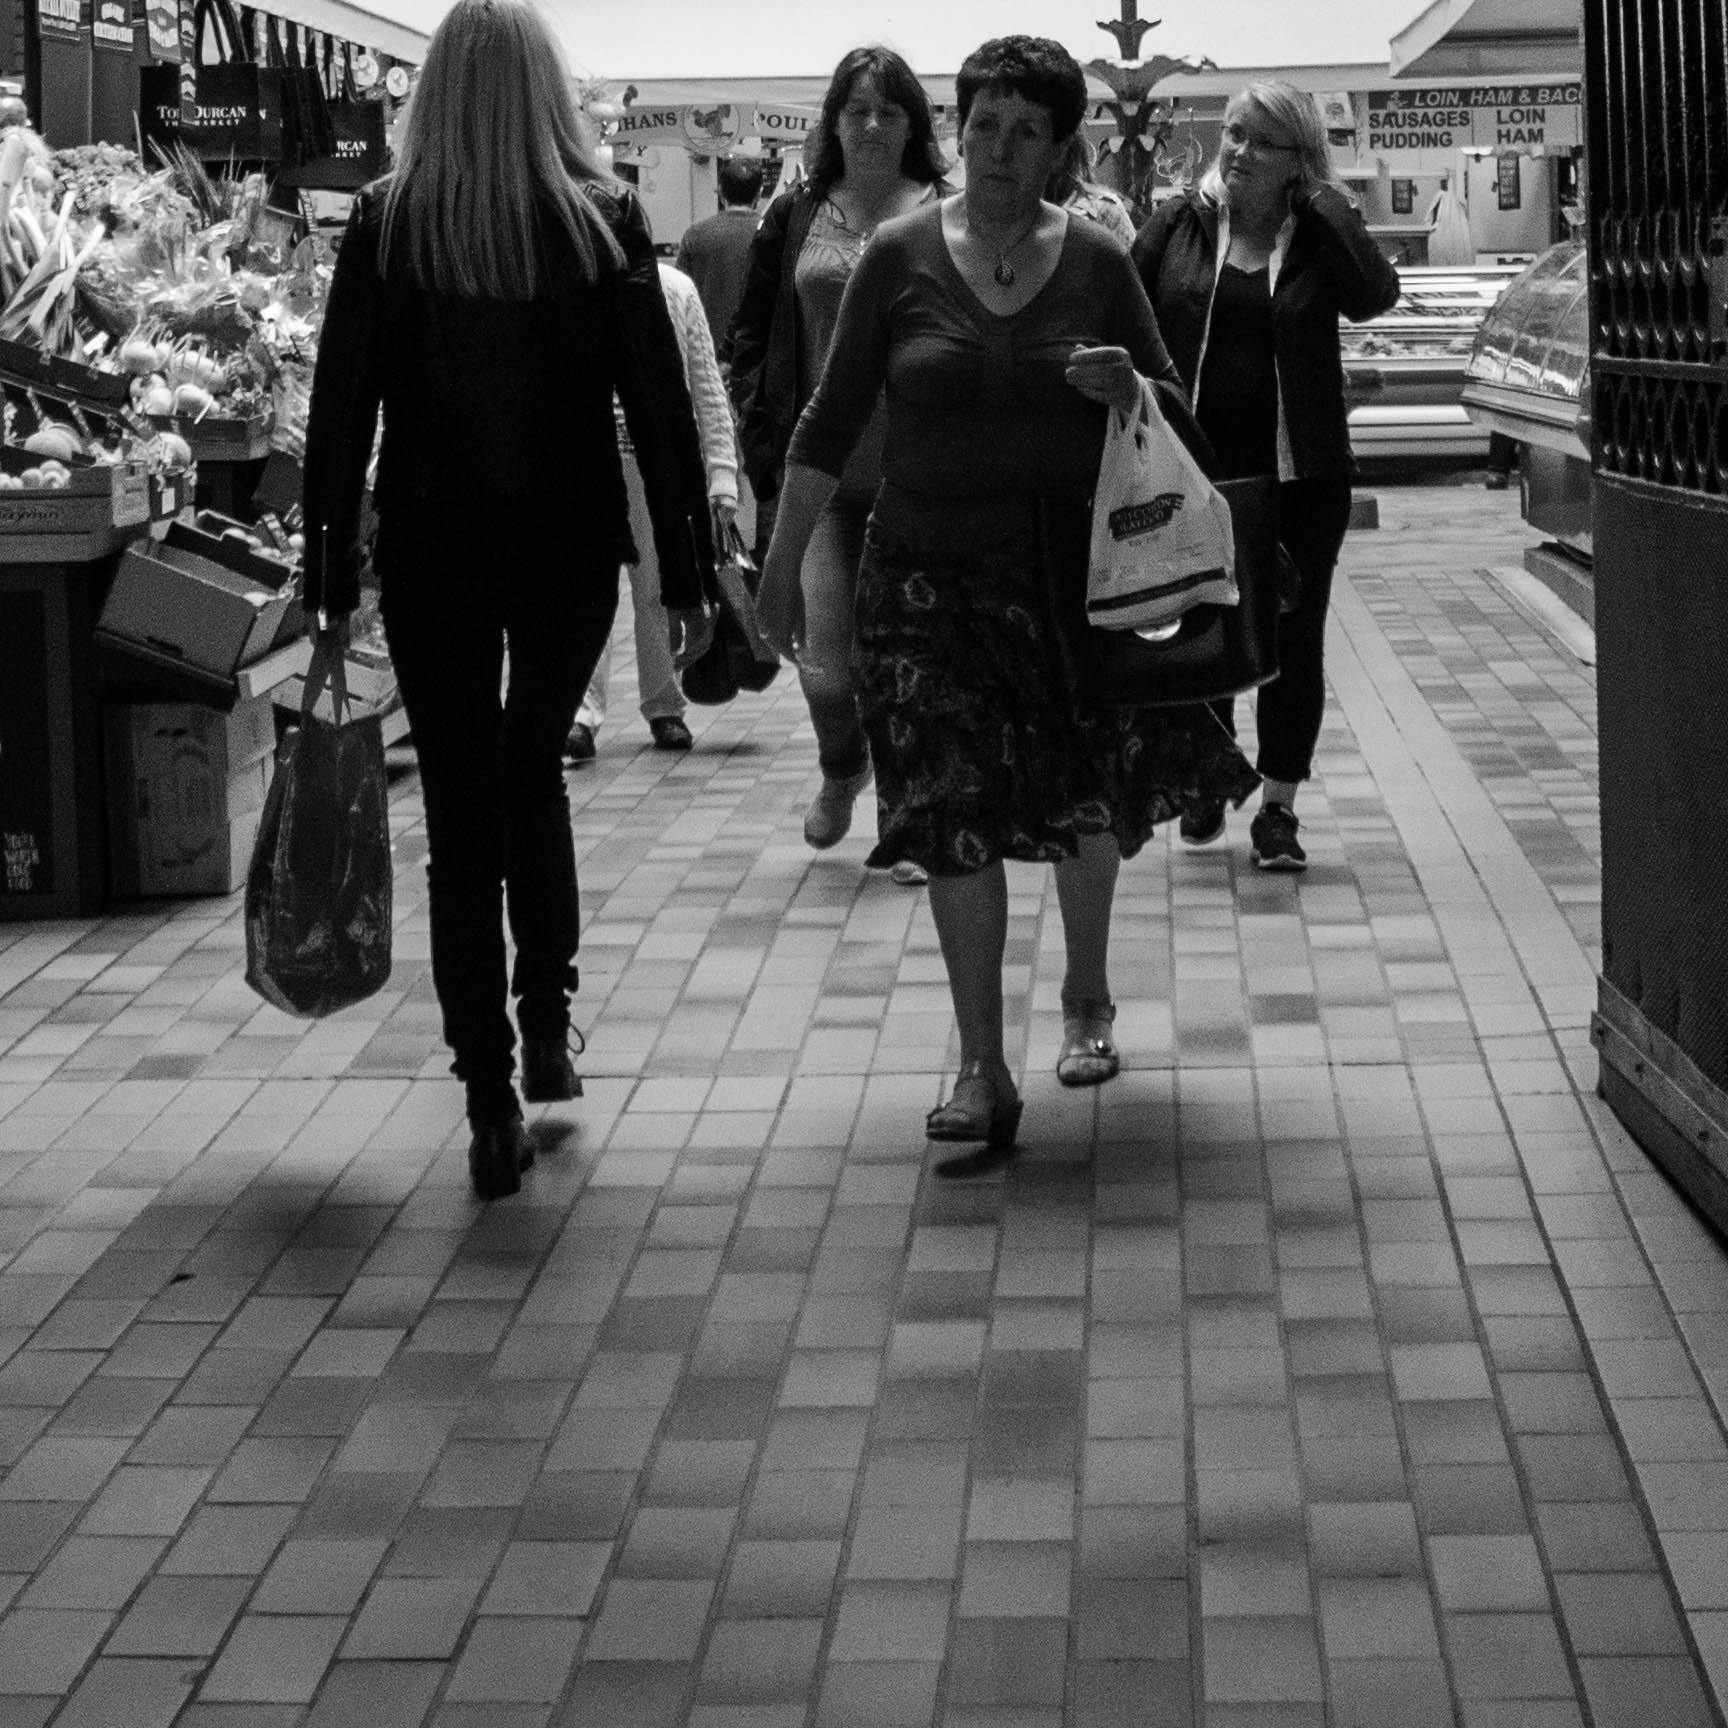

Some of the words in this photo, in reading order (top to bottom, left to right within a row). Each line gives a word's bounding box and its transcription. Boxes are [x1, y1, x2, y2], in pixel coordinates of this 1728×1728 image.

[1414, 92, 1464, 109] LOIN,
[1470, 89, 1514, 106] HAM
[1518, 89, 1532, 105] &
[617, 111, 677, 133] HANS
[1369, 110, 1470, 130] SAUSAGES
[1496, 108, 1546, 125] LOIN
[337, 140, 367, 151] RCAN
[1369, 131, 1453, 150] PUDDING
[1496, 128, 1545, 146] HAM
